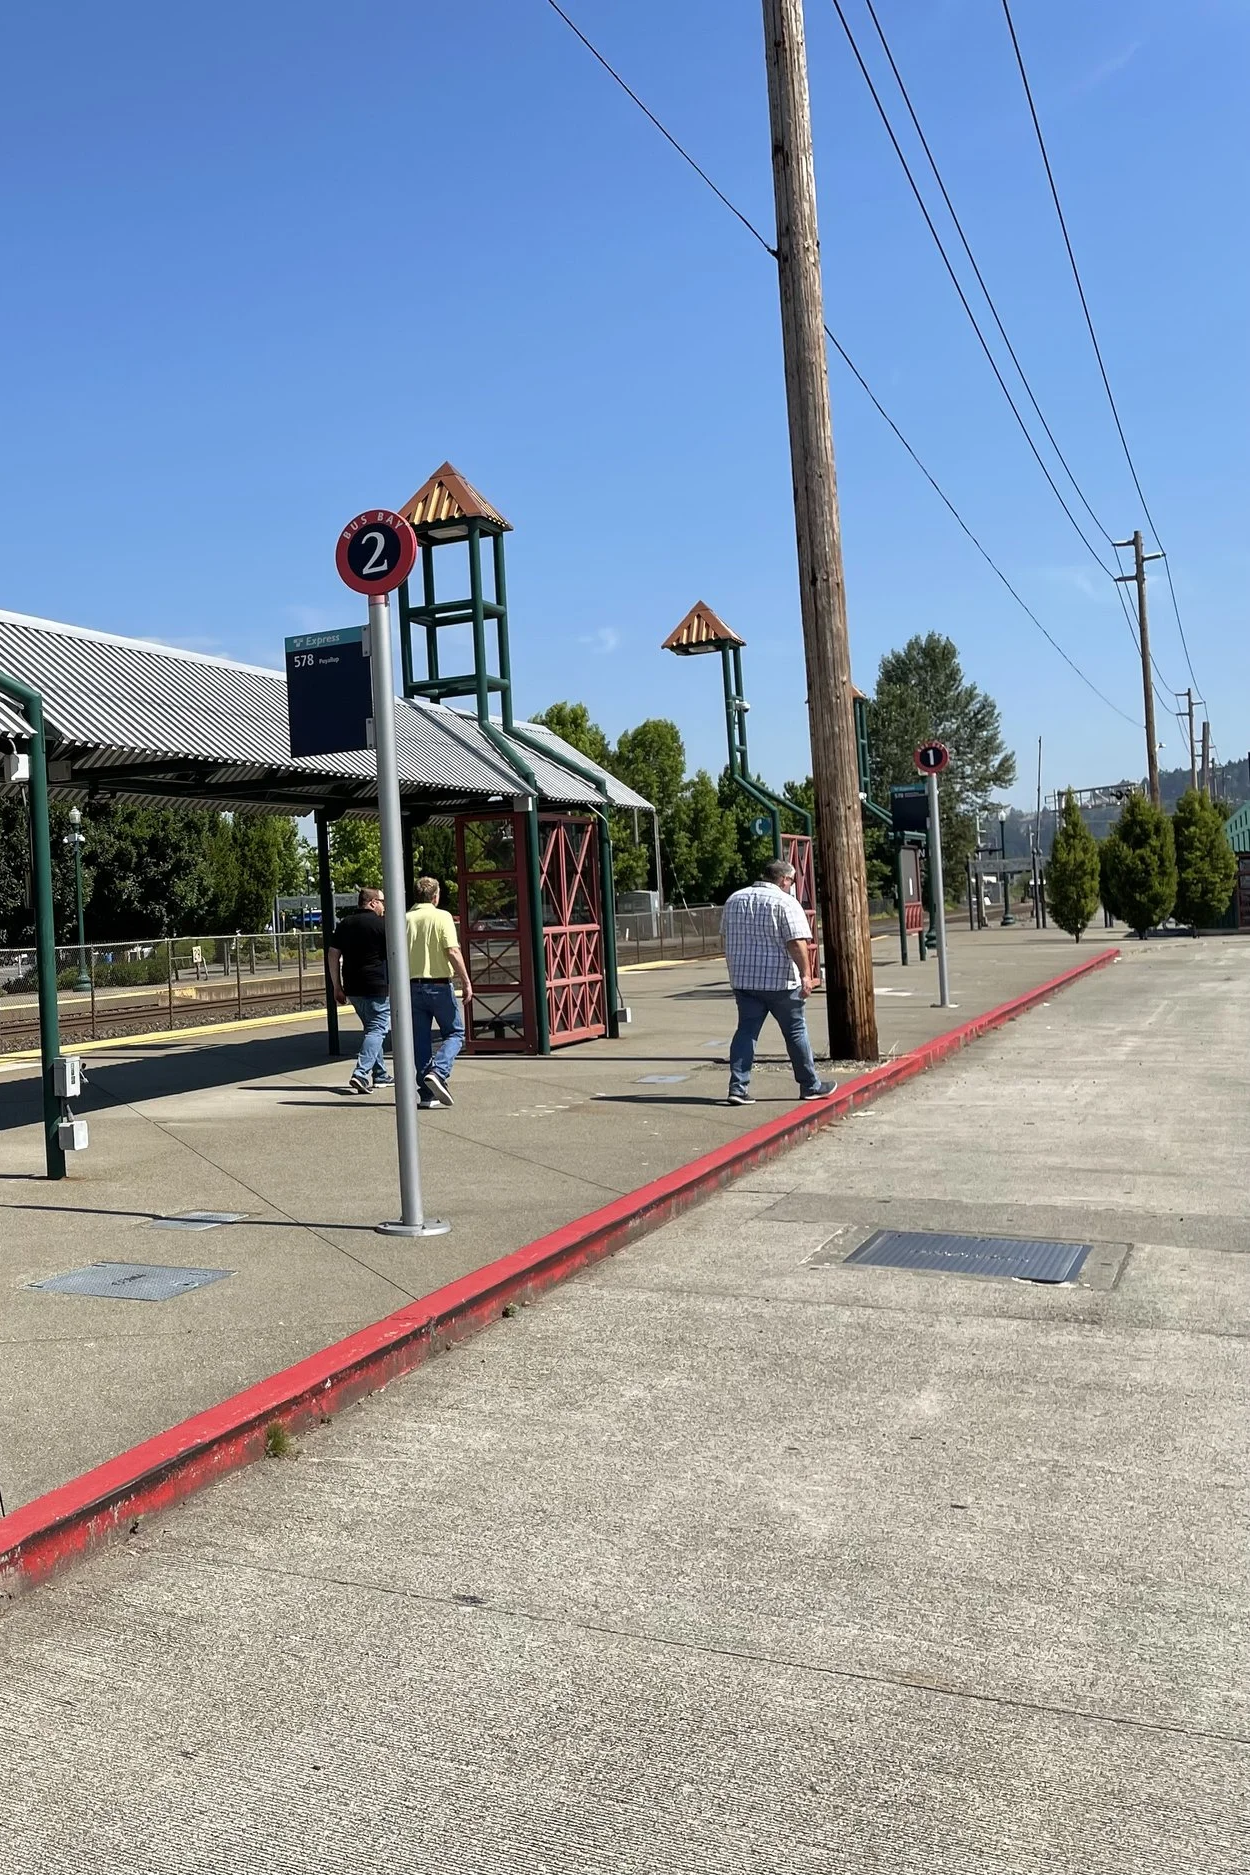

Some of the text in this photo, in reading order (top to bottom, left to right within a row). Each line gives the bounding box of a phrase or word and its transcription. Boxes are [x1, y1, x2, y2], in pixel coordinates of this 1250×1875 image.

[342, 512, 403, 540] BUS BAY
[361, 531, 389, 575] 2
[306, 634, 340, 647] Express
[294, 653, 314, 668] 578
[926, 748, 935, 766] 1
